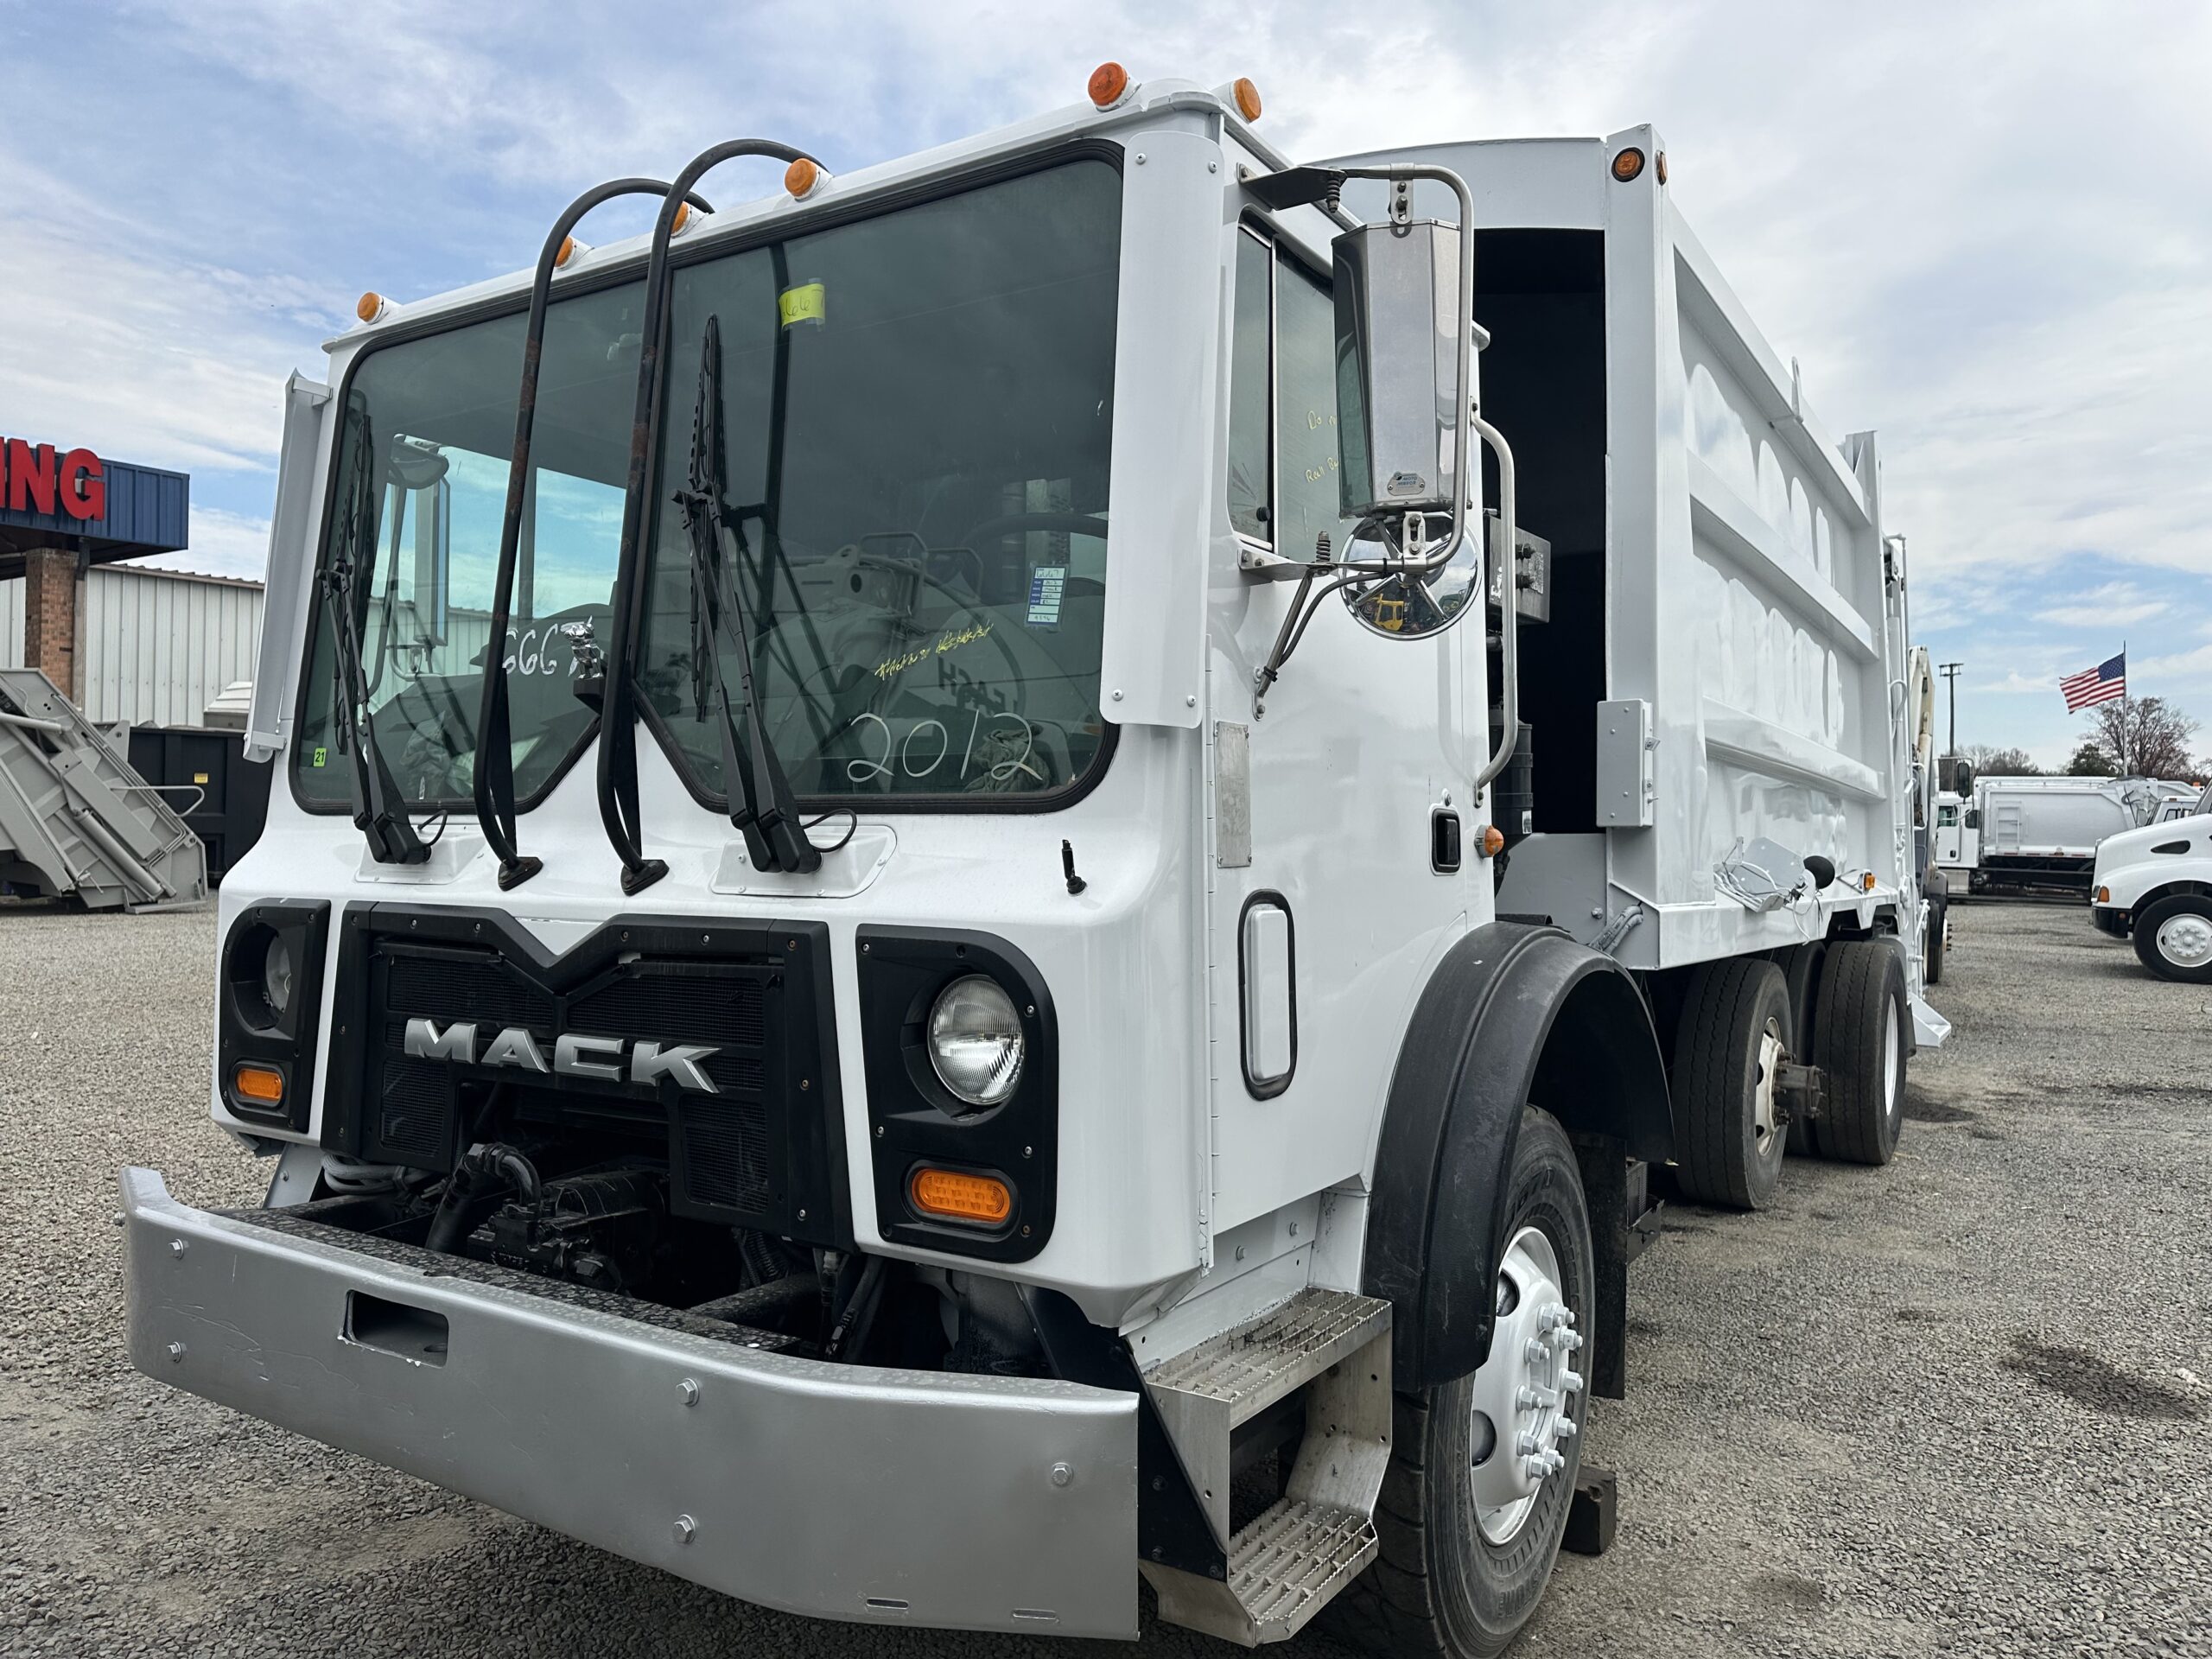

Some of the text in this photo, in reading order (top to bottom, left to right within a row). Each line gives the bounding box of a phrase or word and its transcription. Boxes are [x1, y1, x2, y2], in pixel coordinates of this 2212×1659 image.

[315, 751, 326, 763] 21
[847, 709, 1043, 784] 2012
[404, 1018, 722, 1094] MACK
